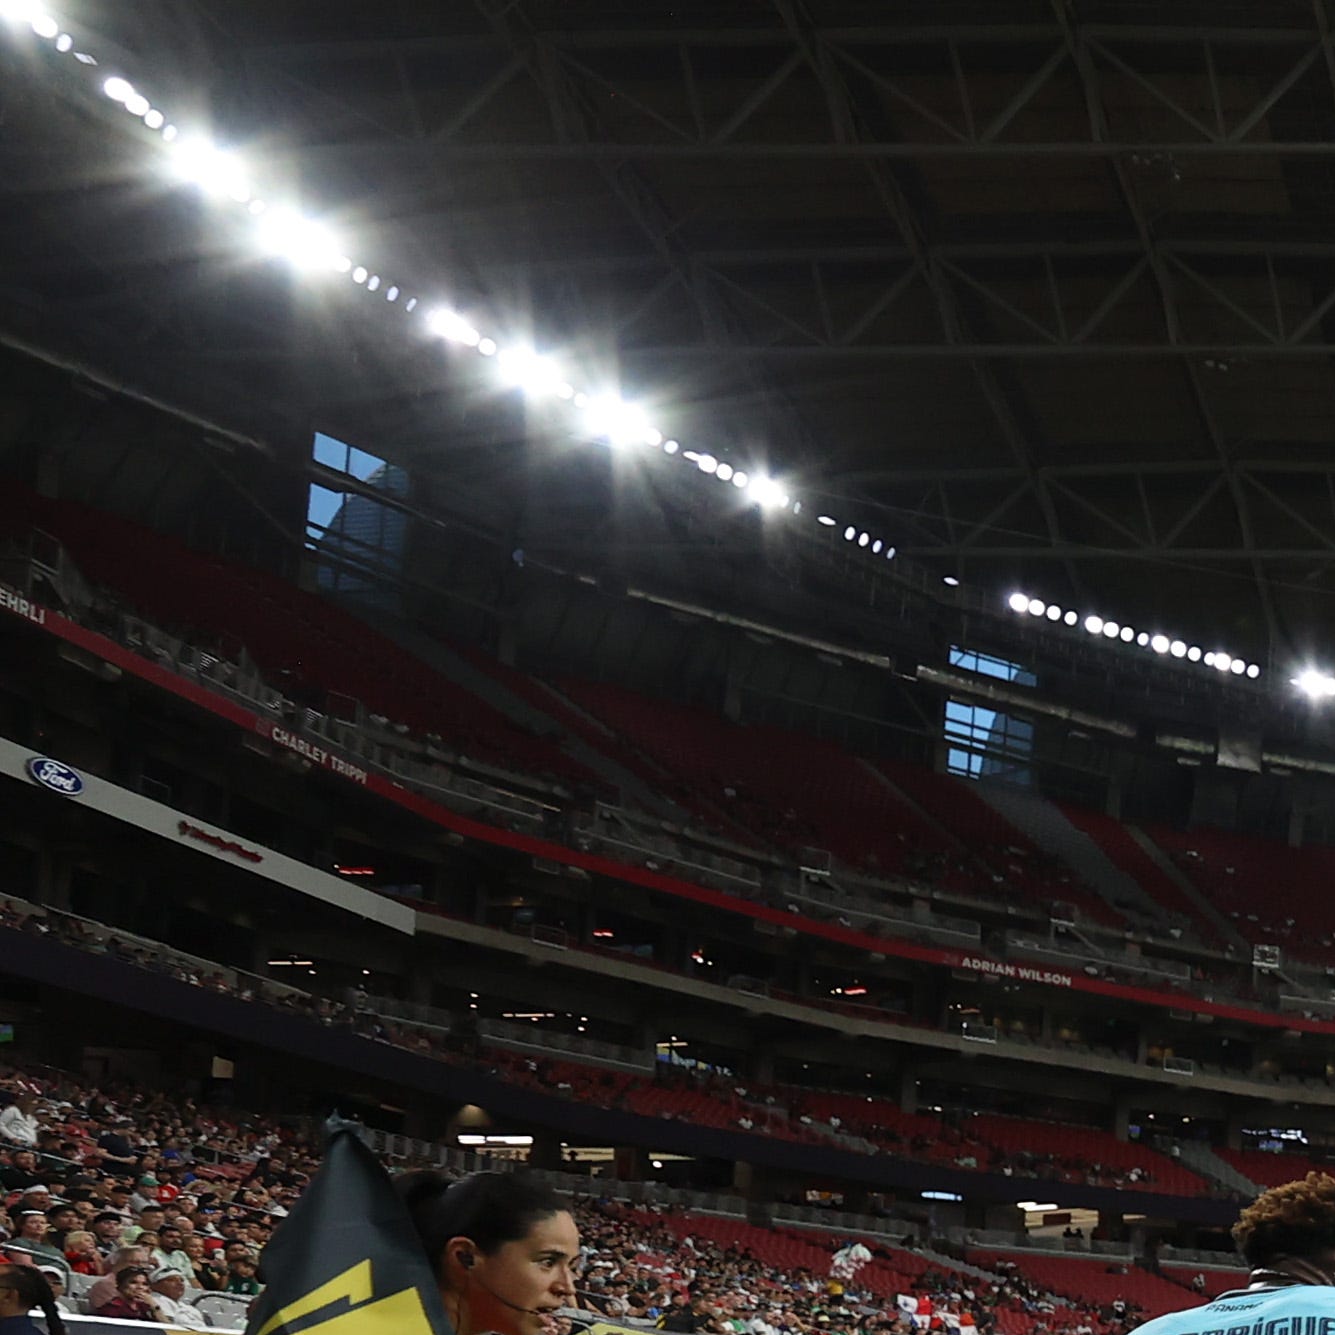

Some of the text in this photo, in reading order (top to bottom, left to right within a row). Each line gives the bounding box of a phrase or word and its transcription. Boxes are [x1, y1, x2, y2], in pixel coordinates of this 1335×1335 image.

[272, 726, 367, 785] CHARLEY TRIPPI
[39, 761, 76, 792] Ford
[962, 957, 1072, 986] ADRIAN WILSON
